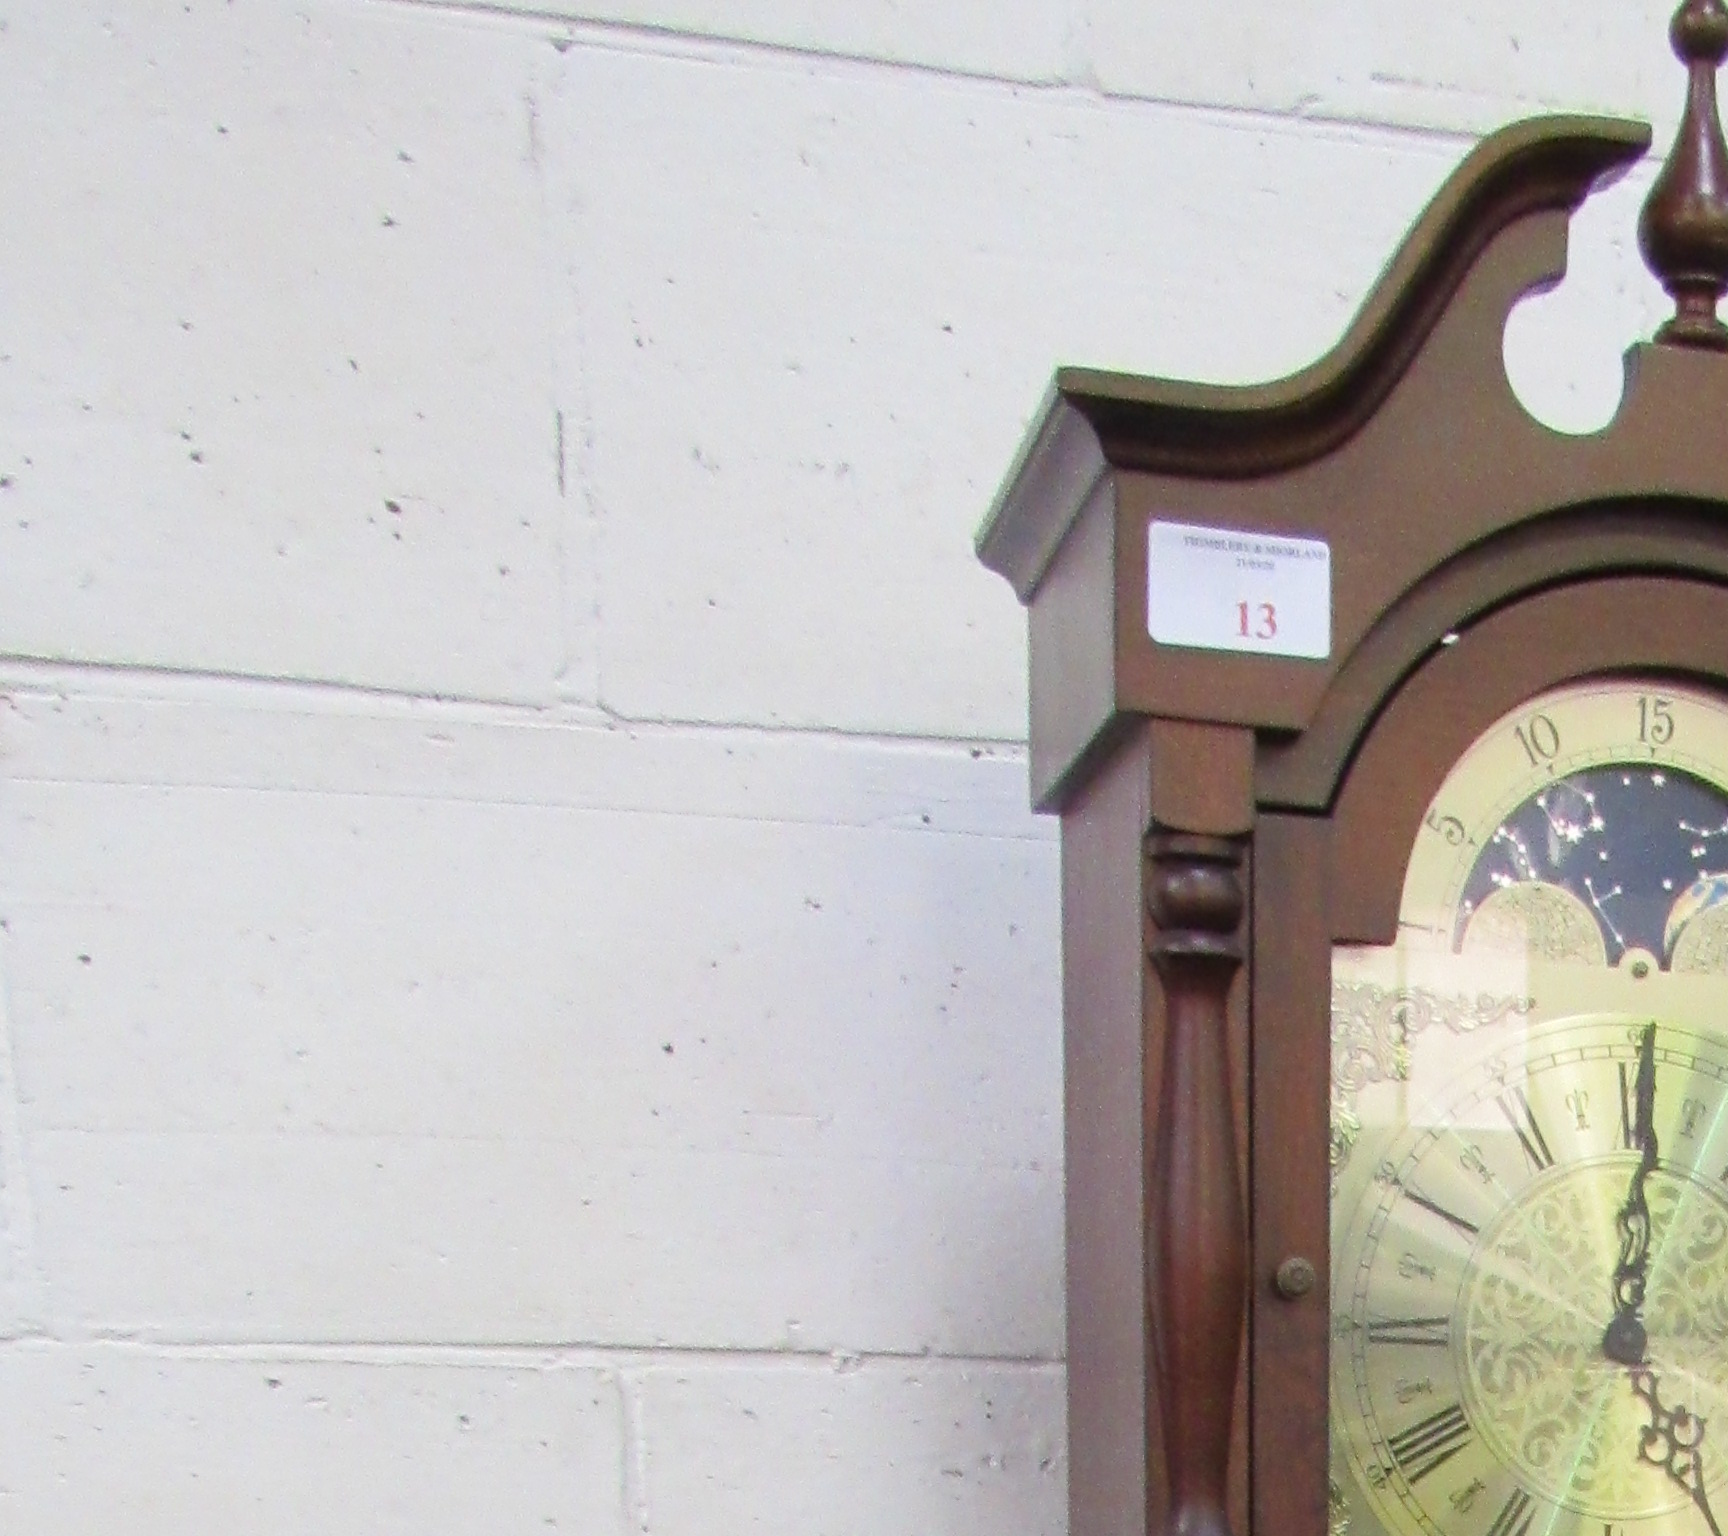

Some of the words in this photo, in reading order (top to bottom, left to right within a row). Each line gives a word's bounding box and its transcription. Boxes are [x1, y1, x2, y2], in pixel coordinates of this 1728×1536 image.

[1236, 599, 1278, 640] 13
[1513, 714, 1560, 766] 10
[1636, 697, 1675, 744] 15
[1426, 814, 1467, 847] 5
